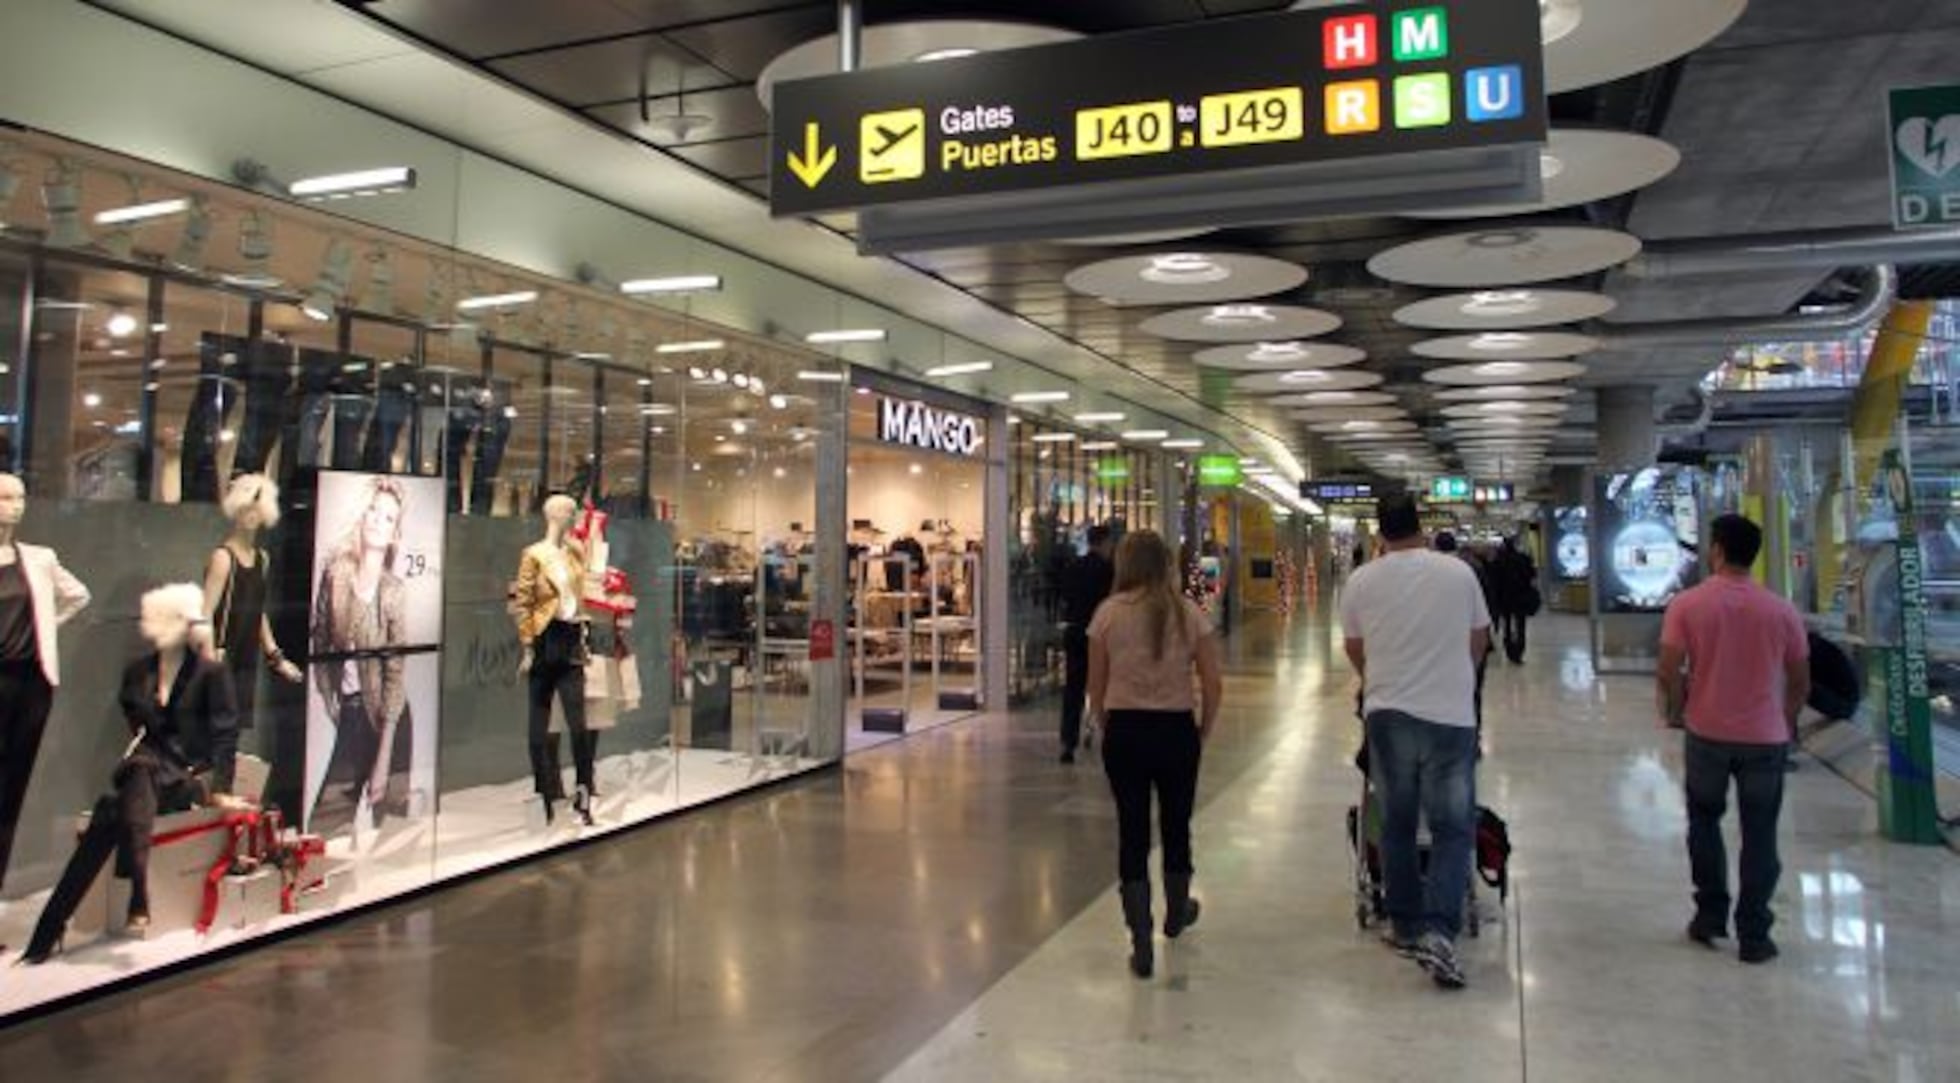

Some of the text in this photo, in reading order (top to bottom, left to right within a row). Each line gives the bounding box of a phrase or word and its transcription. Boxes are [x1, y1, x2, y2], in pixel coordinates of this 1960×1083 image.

[1334, 14, 1439, 61] H M
[940, 104, 1015, 134] Gates
[1088, 97, 1288, 149] J40 to J49
[1336, 73, 1510, 126] R S U
[941, 133, 1057, 171] Puertas
[884, 396, 977, 456] MANGO
